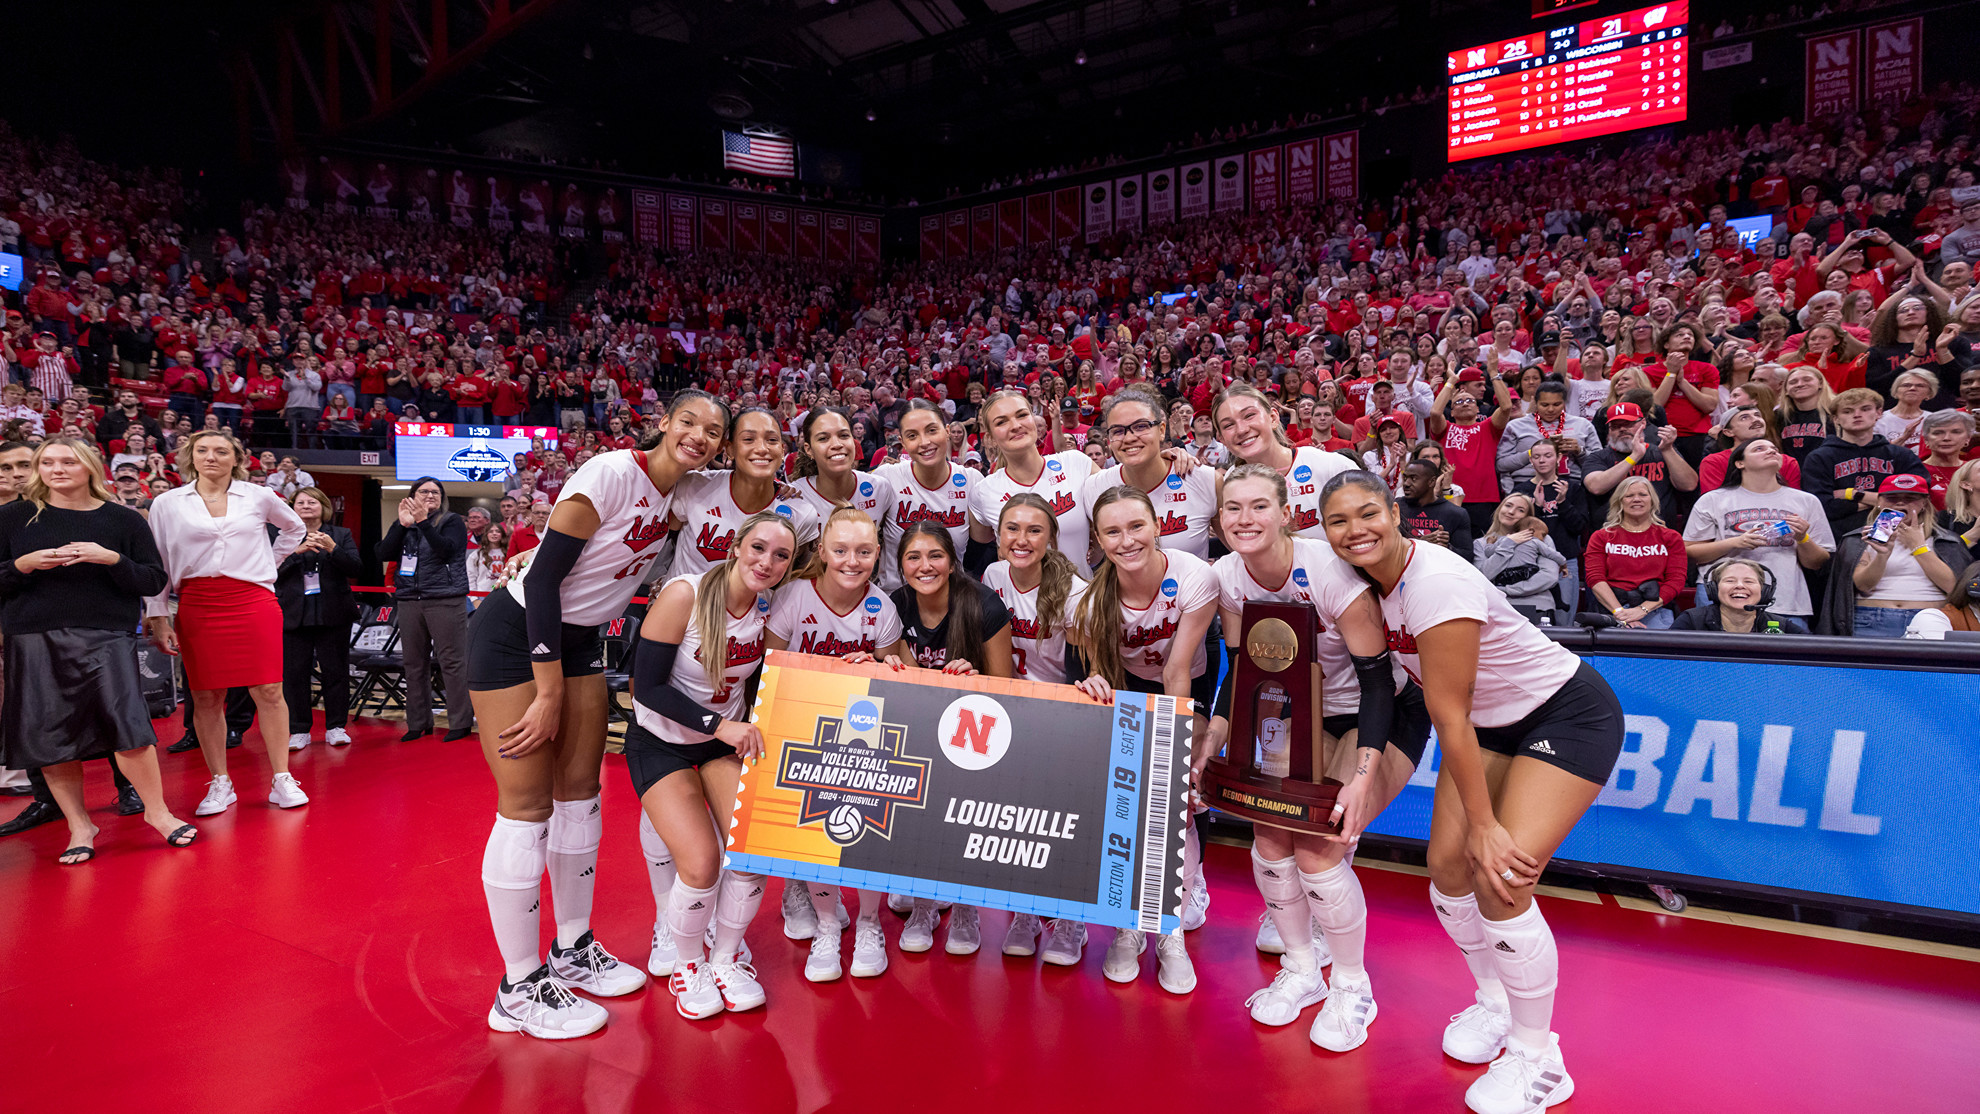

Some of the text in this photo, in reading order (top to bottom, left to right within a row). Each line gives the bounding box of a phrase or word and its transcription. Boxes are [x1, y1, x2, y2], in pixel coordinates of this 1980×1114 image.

[1601, 18, 1621, 37] 21
[1503, 40, 1527, 59] 25
[1553, 39, 1571, 50] 2-0
[1565, 27, 1682, 60] WISCONSIN K B D
[1875, 26, 1911, 58] N
[1467, 48, 1486, 68] N
[1565, 63, 1576, 73] 10
[1672, 41, 1681, 51] 0
[1815, 37, 1850, 69] N
[1452, 54, 1557, 84] NEBRASKA K B D
[1874, 57, 1910, 71] NCAA
[1521, 73, 1529, 82] 0
[1536, 69, 1544, 78] 4
[1814, 69, 1849, 82] NCAA
[1451, 100, 1461, 109] 10
[1521, 86, 1529, 95] 0
[1535, 82, 1544, 92] 0
[1521, 98, 1529, 107] 4
[1562, 102, 1576, 112] 22
[1641, 101, 1650, 111] 0
[1520, 111, 1530, 121] 10
[1520, 124, 1530, 134] 10
[1535, 121, 1543, 131] 4
[1290, 144, 1313, 169] N
[1329, 136, 1352, 162] N
[1254, 152, 1276, 175] N
[1615, 404, 1625, 415] N
[407, 424, 421, 436] N
[468, 426, 491, 436] 1:30
[512, 428, 525, 438] 21
[361, 453, 379, 464] EXIT
[1834, 456, 1895, 480] NEBRASKA
[897, 500, 966, 528] Nebraska
[1605, 541, 1668, 558] NEBRASKA
[376, 606, 392, 622] N
[606, 618, 626, 637] N
[800, 630, 876, 657] Nebraska
[1250, 641, 1295, 662] NCAA
[1260, 692, 1287, 703] DIVISION
[850, 713, 877, 726] NCAA
[949, 707, 997, 757] N
[821, 751, 888, 772] VOLLEYBALL
[848, 748, 875, 756] WOMEN'S
[787, 761, 918, 795] CHAMPIONSHIP
[818, 791, 837, 801] 2024
[841, 794, 880, 807] LOUISVILLE
[1107, 702, 1142, 909] SECTION 12 ROW 19 SEAT 24
[1222, 788, 1303, 816] REGIONAL CHAMPION
[944, 797, 1080, 840] LOUISVILLE
[963, 832, 1051, 869] BOUND
